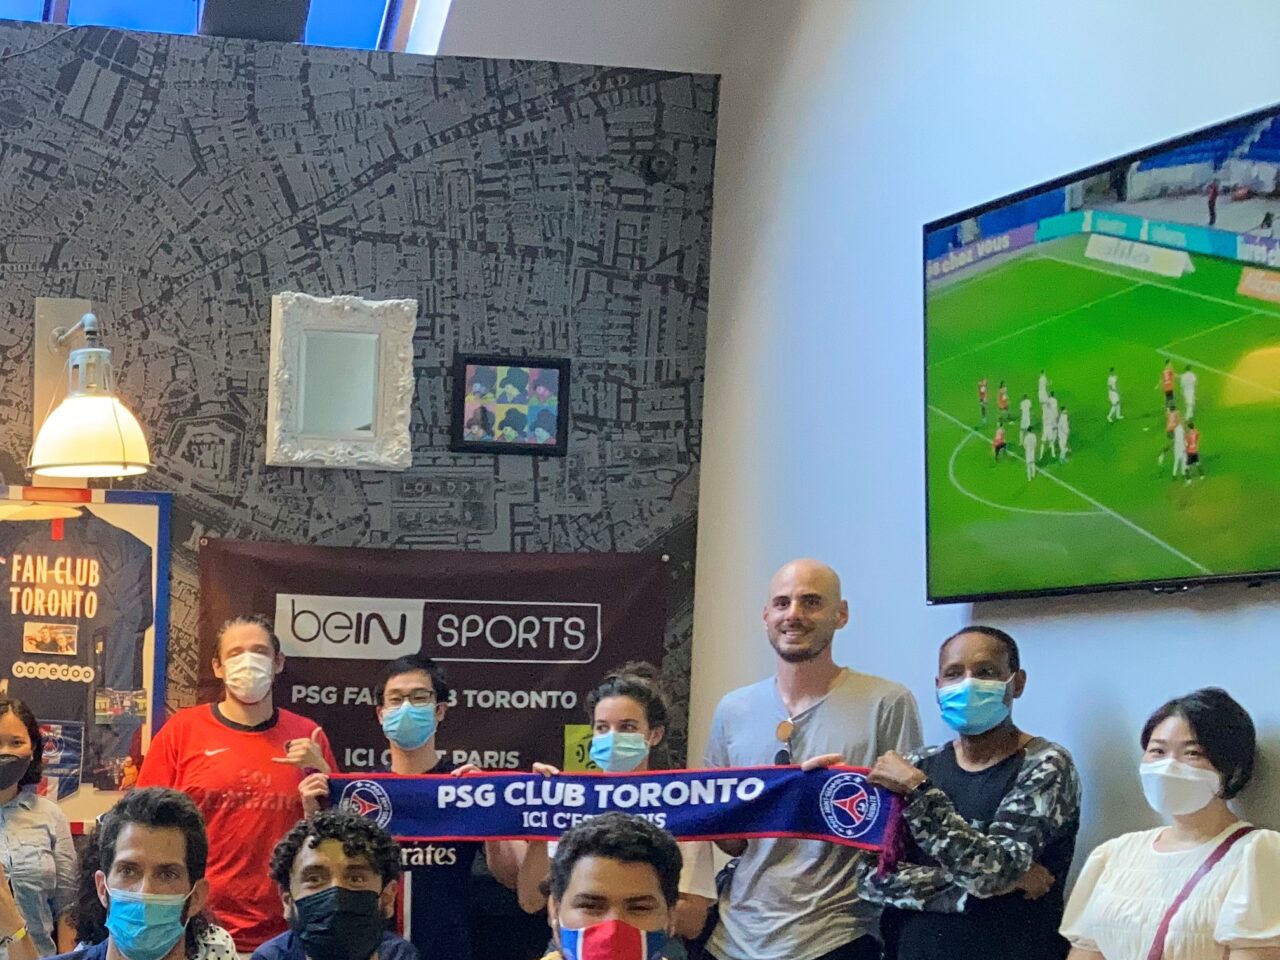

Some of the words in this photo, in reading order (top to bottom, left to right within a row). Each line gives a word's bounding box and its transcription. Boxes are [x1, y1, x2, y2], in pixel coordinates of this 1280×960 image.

[11, 554, 48, 583] FAN
[53, 556, 100, 587] CLUB
[9, 587, 98, 619] TORONTO
[436, 614, 586, 650] SPORTS
[13, 662, 94, 682] ooredoo
[292, 685, 337, 705] PSG
[342, 687, 377, 706] FA
[463, 690, 577, 709] TORONTO
[345, 749, 374, 767] ICI
[453, 751, 519, 769] PARIS
[437, 783, 496, 809] PSG
[504, 782, 585, 808] CLUB
[596, 777, 764, 809] TORONTO
[522, 811, 548, 828] ICI
